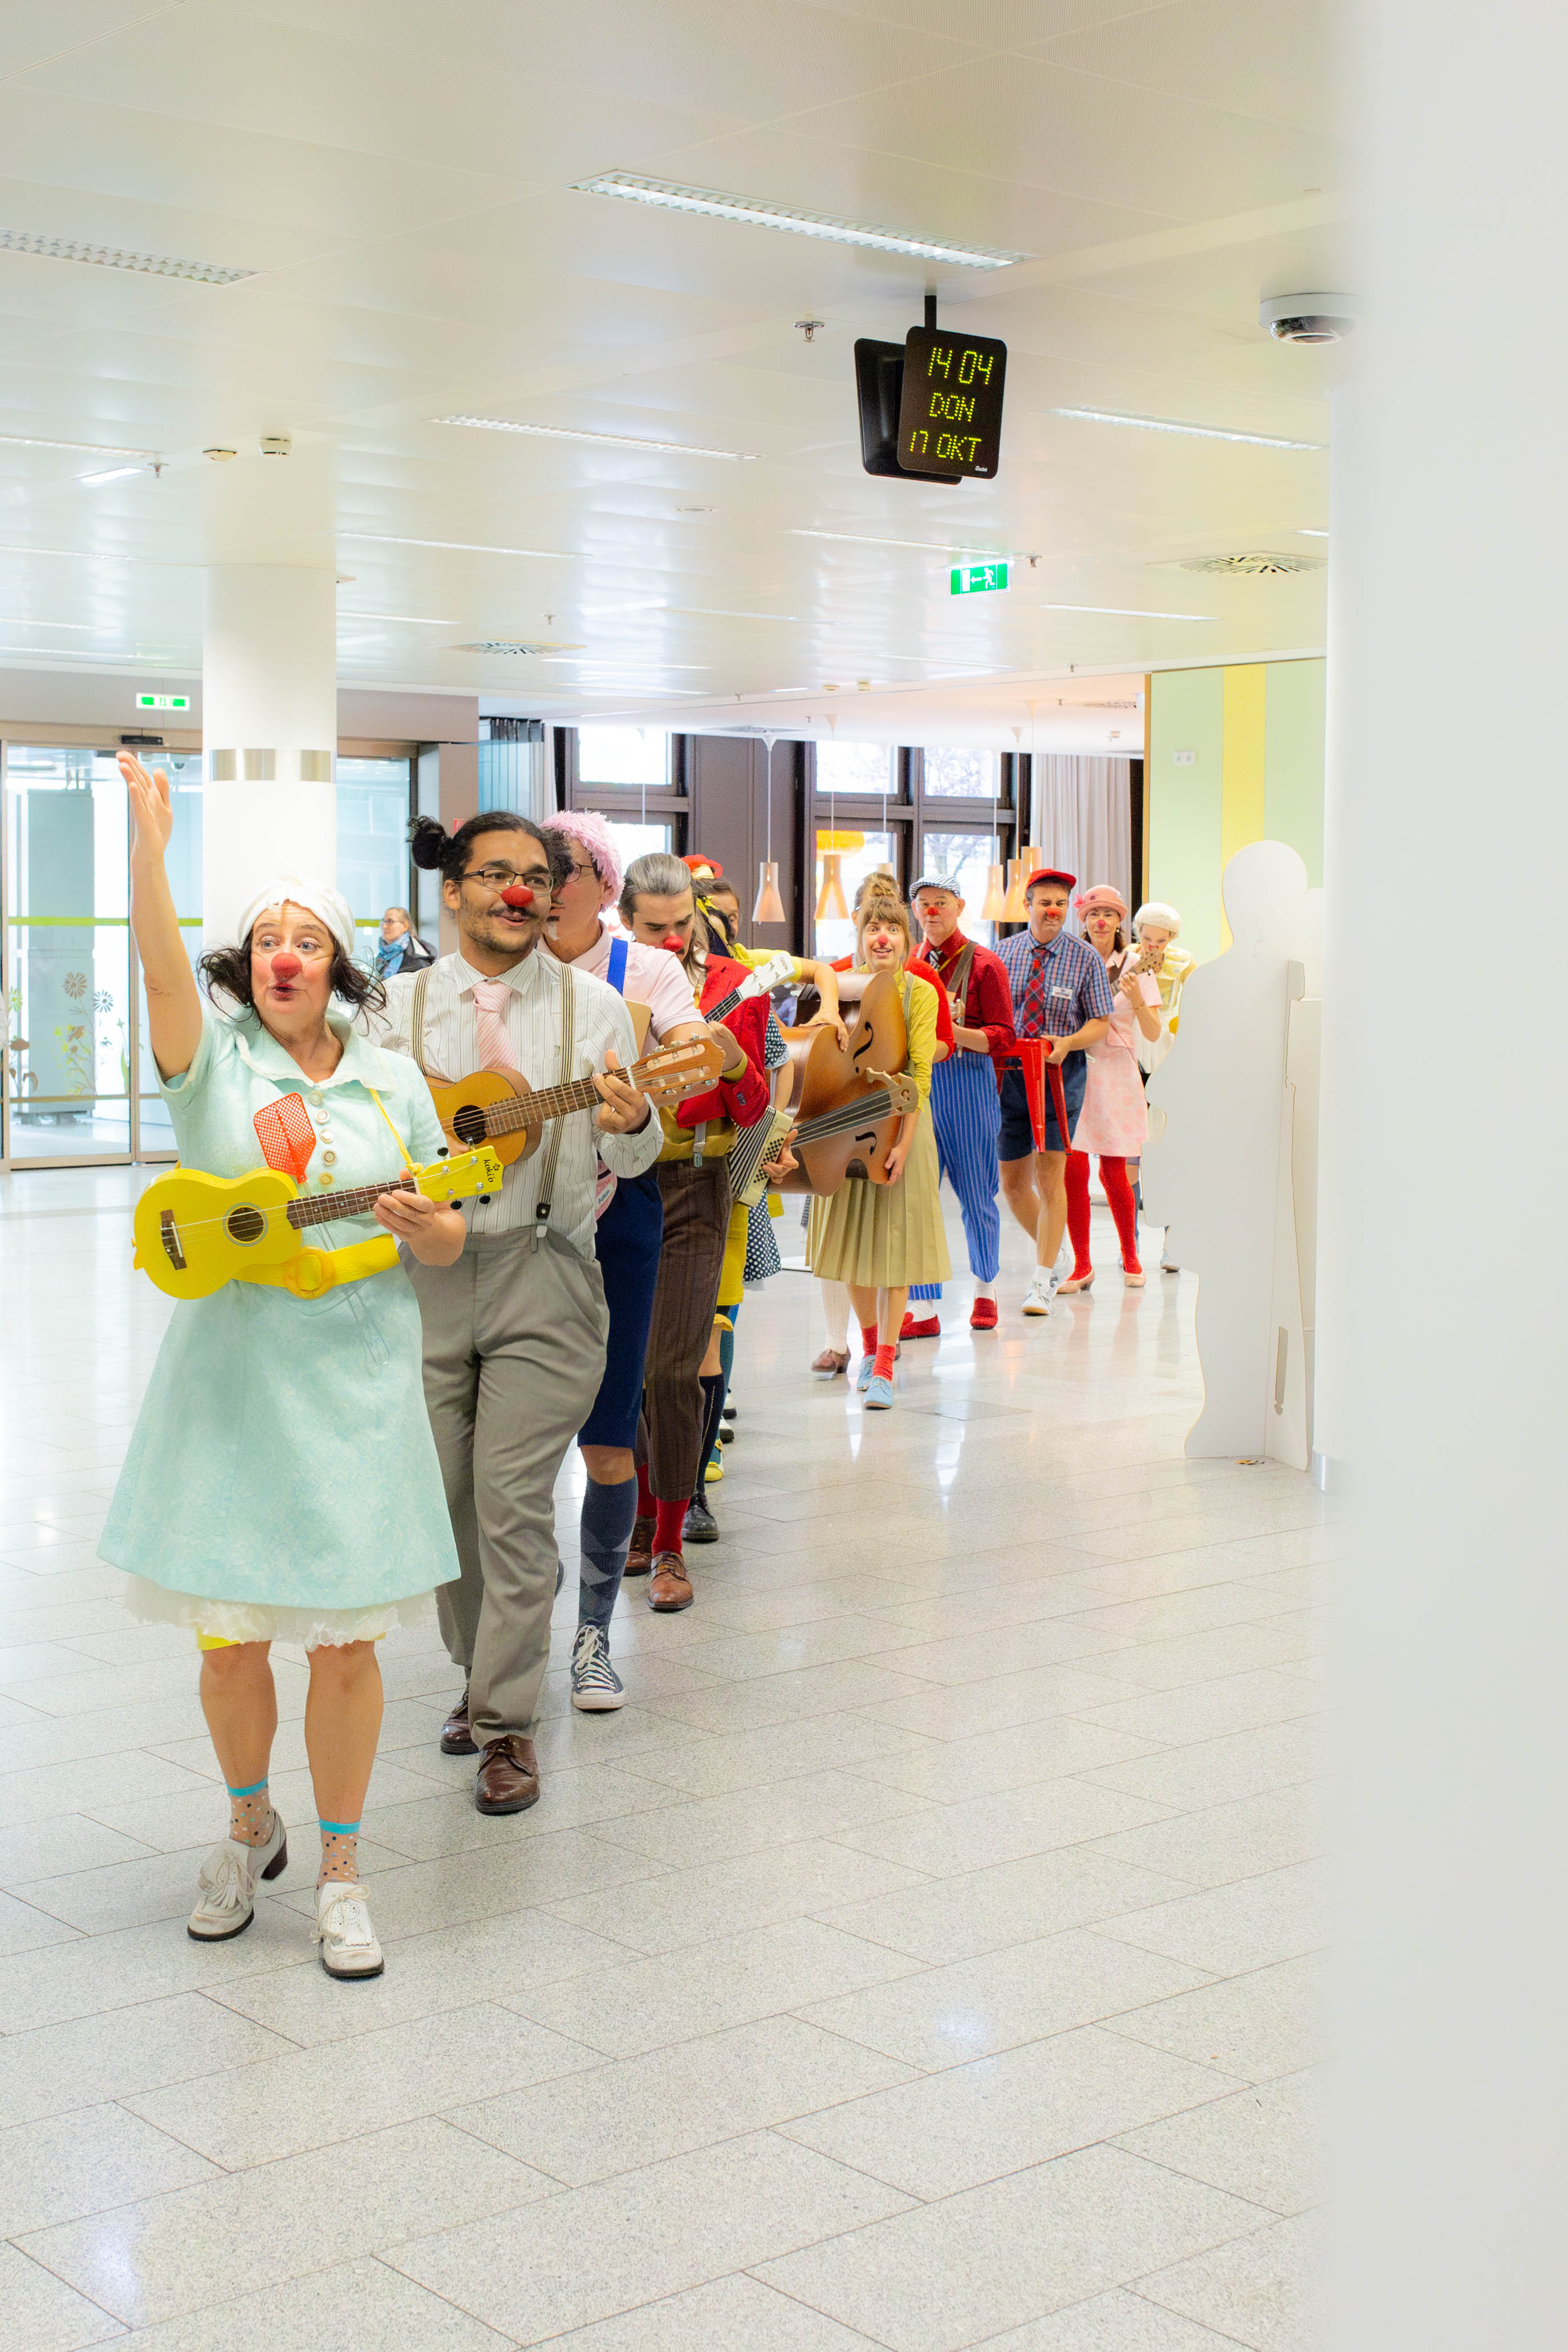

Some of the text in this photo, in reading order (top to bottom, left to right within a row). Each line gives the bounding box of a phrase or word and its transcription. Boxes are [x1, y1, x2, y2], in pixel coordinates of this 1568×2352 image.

[928, 347, 993, 385] 14 04
[929, 392, 976, 422] DON
[910, 430, 982, 462] 17 OKT
